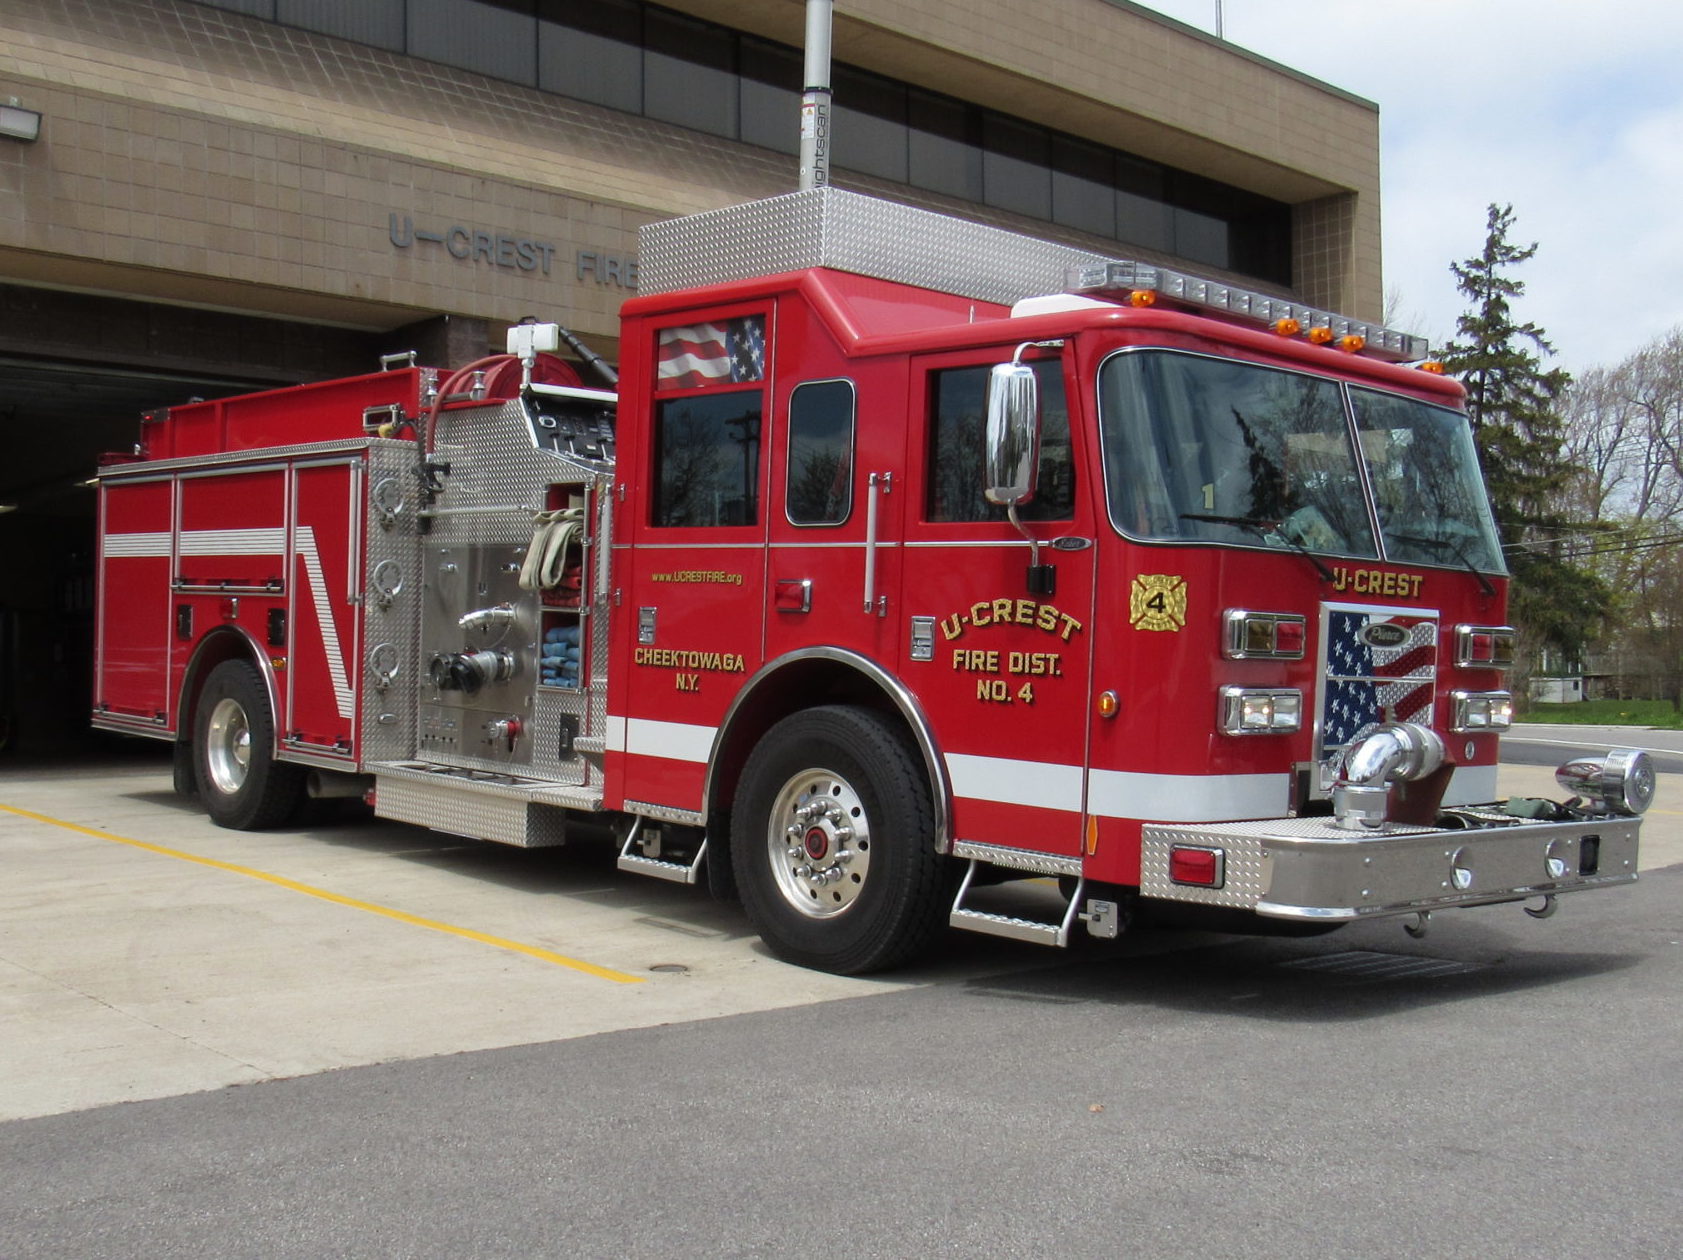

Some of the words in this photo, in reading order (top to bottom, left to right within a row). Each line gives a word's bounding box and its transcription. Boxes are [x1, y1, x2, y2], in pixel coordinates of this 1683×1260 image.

[389, 212, 555, 275] U-CREST
[576, 250, 638, 289] FIRE
[1202, 483, 1214, 509] 1
[652, 571, 742, 585] www.UCRESTFIRE.org
[1332, 567, 1423, 597] U-CREST
[1146, 592, 1166, 614] 4
[940, 598, 1082, 640] U-CREST
[634, 648, 745, 672] CHEEKTOWAGA
[953, 649, 999, 672] FIRE
[1008, 652, 1061, 676] DIST.
[676, 673, 699, 691] N.Y.
[977, 679, 1012, 702] NO.
[1018, 683, 1033, 703] 4
